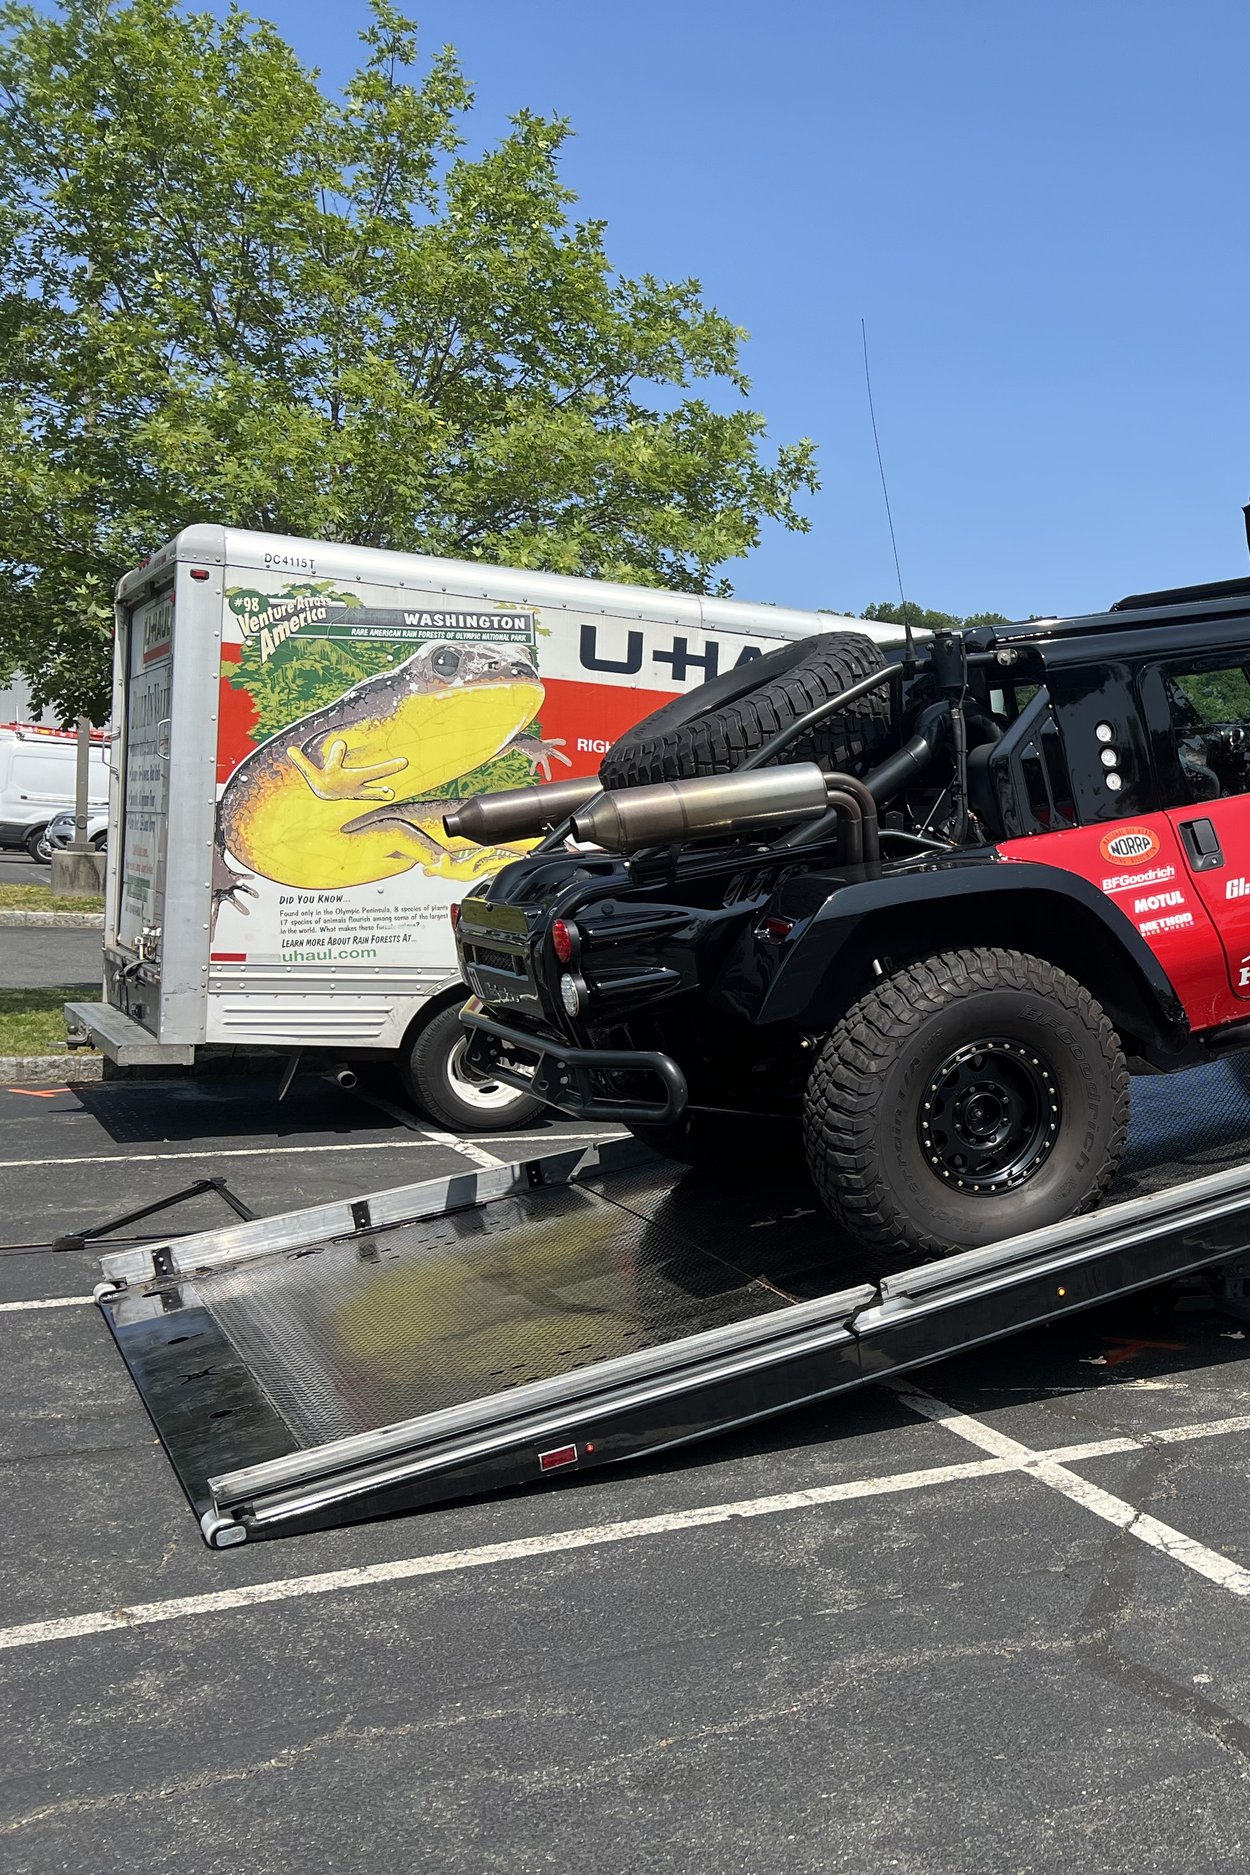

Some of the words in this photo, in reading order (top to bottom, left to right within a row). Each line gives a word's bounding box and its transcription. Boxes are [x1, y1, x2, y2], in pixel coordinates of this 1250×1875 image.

[264, 553, 316, 569] DC4115T
[234, 597, 260, 612] #98
[237, 603, 294, 638] Venture
[403, 612, 526, 630] WASHINGTON
[260, 607, 328, 664] America
[351, 628, 368, 636] RARE
[369, 629, 401, 637] AMERICAN
[402, 630, 418, 638] RAIN
[418, 630, 446, 639] FORESTS
[446, 631, 455, 640] OF
[456, 632, 482, 640] OLYMPIC
[482, 633, 510, 641] NATIONAL
[510, 634, 526, 642] PARK
[1110, 836, 1151, 856] NORRA
[1102, 866, 1174, 890] BFGoodrich
[279, 896, 294, 904] DID
[297, 895, 315, 904] YOU
[1134, 890, 1184, 914] MOTUL
[335, 908, 360, 916] Olympic
[1139, 912, 1192, 932] METHOD
[1140, 929, 1161, 937] RACE
[1164, 920, 1194, 932] WHEELS
[282, 938, 304, 948] LEARN
[305, 938, 326, 947] MORE
[327, 936, 351, 946] ABOUT
[352, 936, 369, 944] RAIN
[370, 934, 400, 944] FORESTS
[282, 948, 377, 962] uhaul.com
